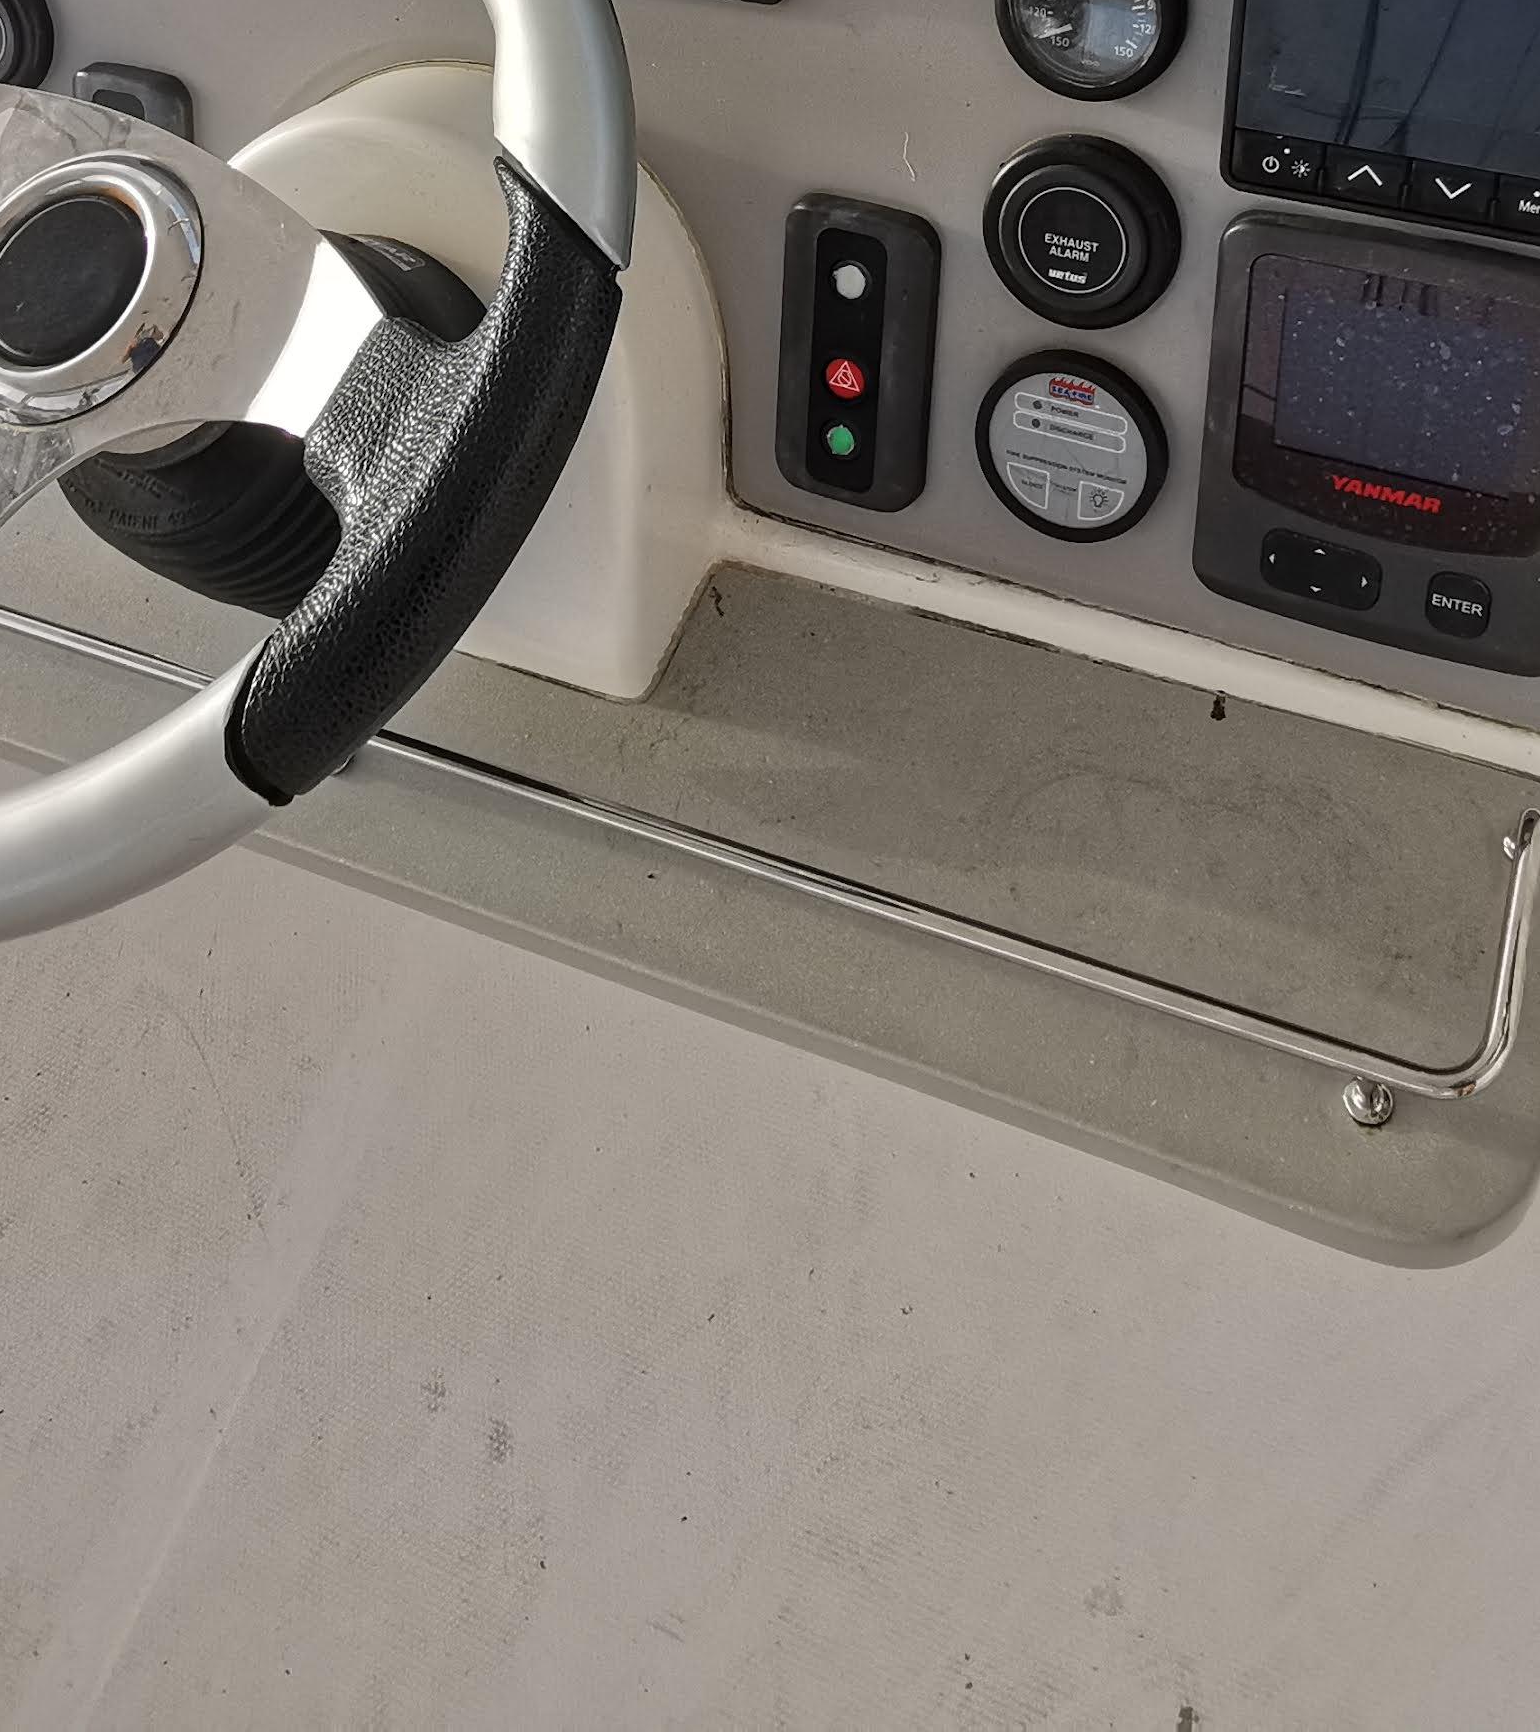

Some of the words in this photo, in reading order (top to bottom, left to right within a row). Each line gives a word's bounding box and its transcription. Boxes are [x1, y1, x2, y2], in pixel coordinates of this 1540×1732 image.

[1114, 46, 1134, 58] 150
[1044, 232, 1099, 253] EXHAUST
[1049, 245, 1090, 263] ALARM
[1332, 474, 1442, 514] YANMAR
[1431, 593, 1484, 618] ENTER
